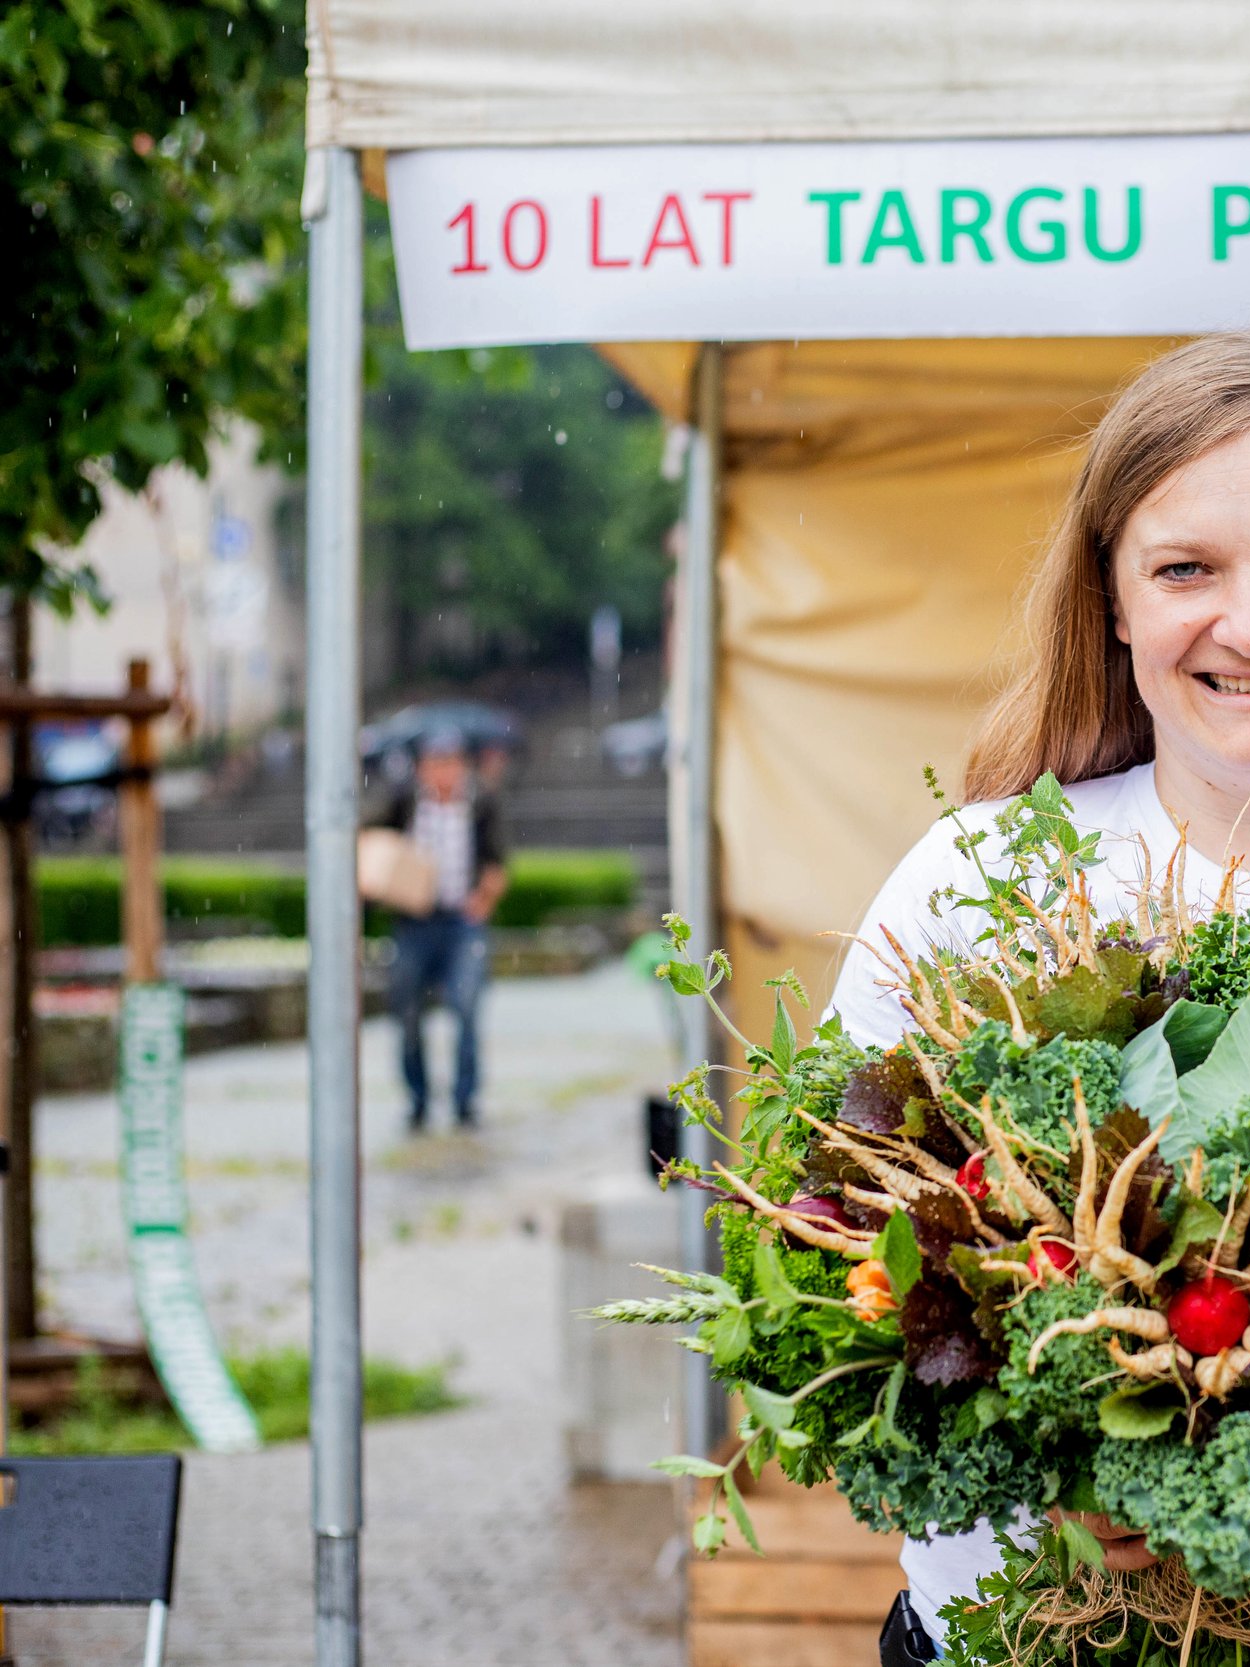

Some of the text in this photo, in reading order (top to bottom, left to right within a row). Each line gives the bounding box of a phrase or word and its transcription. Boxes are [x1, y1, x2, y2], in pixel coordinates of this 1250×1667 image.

[447, 199, 549, 275] 10
[589, 191, 752, 269] LAT
[806, 184, 1144, 266] TARGU
